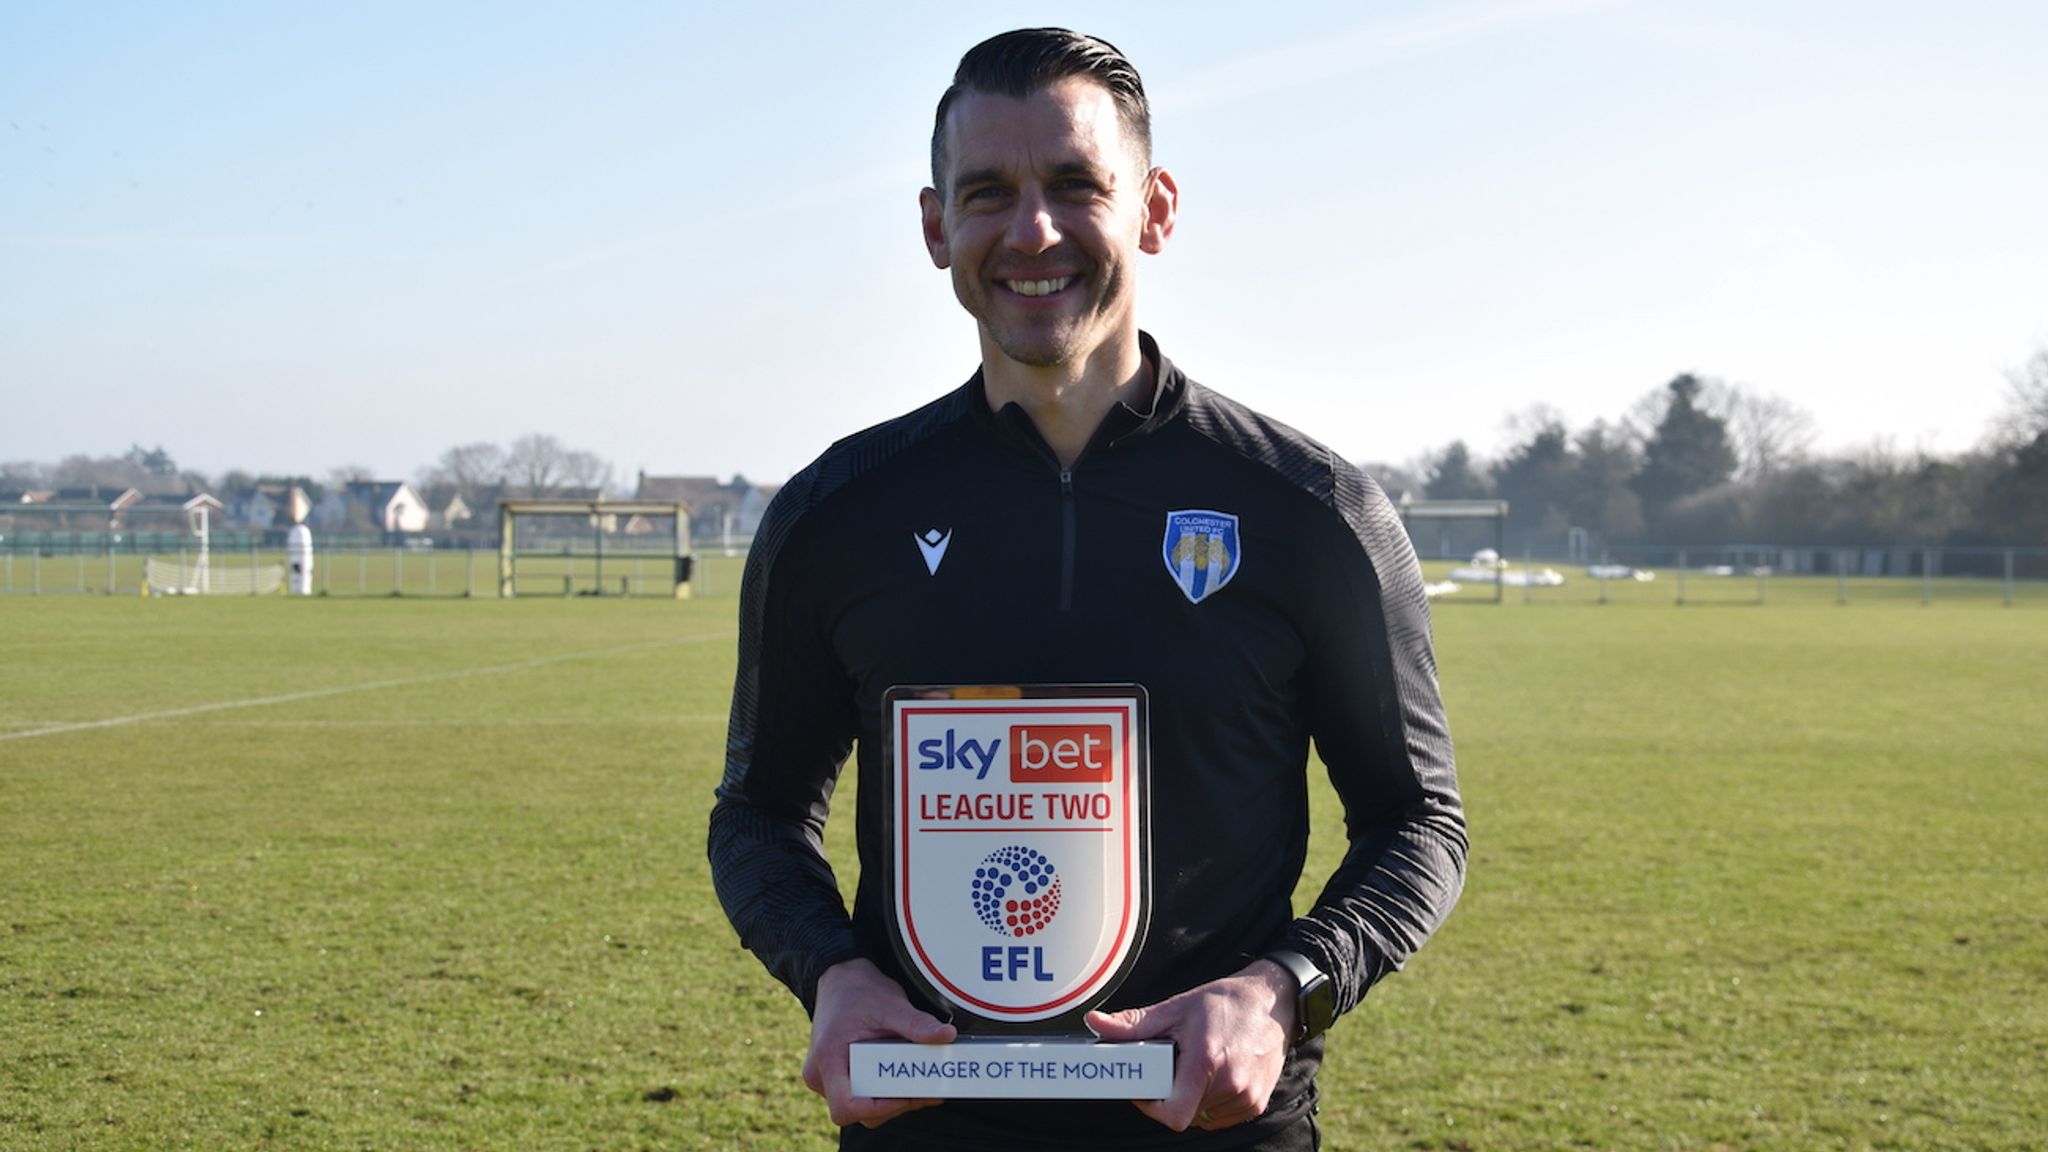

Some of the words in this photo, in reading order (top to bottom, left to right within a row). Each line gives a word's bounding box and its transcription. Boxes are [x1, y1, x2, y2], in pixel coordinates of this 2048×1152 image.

[1174, 516, 1232, 528] COLCHESTER
[1180, 525, 1211, 533] UNITED
[918, 729, 1001, 780] sky
[1020, 730, 1102, 770] bet
[919, 793, 1034, 821] LEAGUE
[1042, 793, 1111, 821] TWO
[981, 946, 1054, 982] EFL
[878, 1060, 981, 1080] MANAGER
[987, 1061, 1015, 1080] OF
[1018, 1061, 1057, 1080] THE
[1063, 1062, 1143, 1080] MONTH
